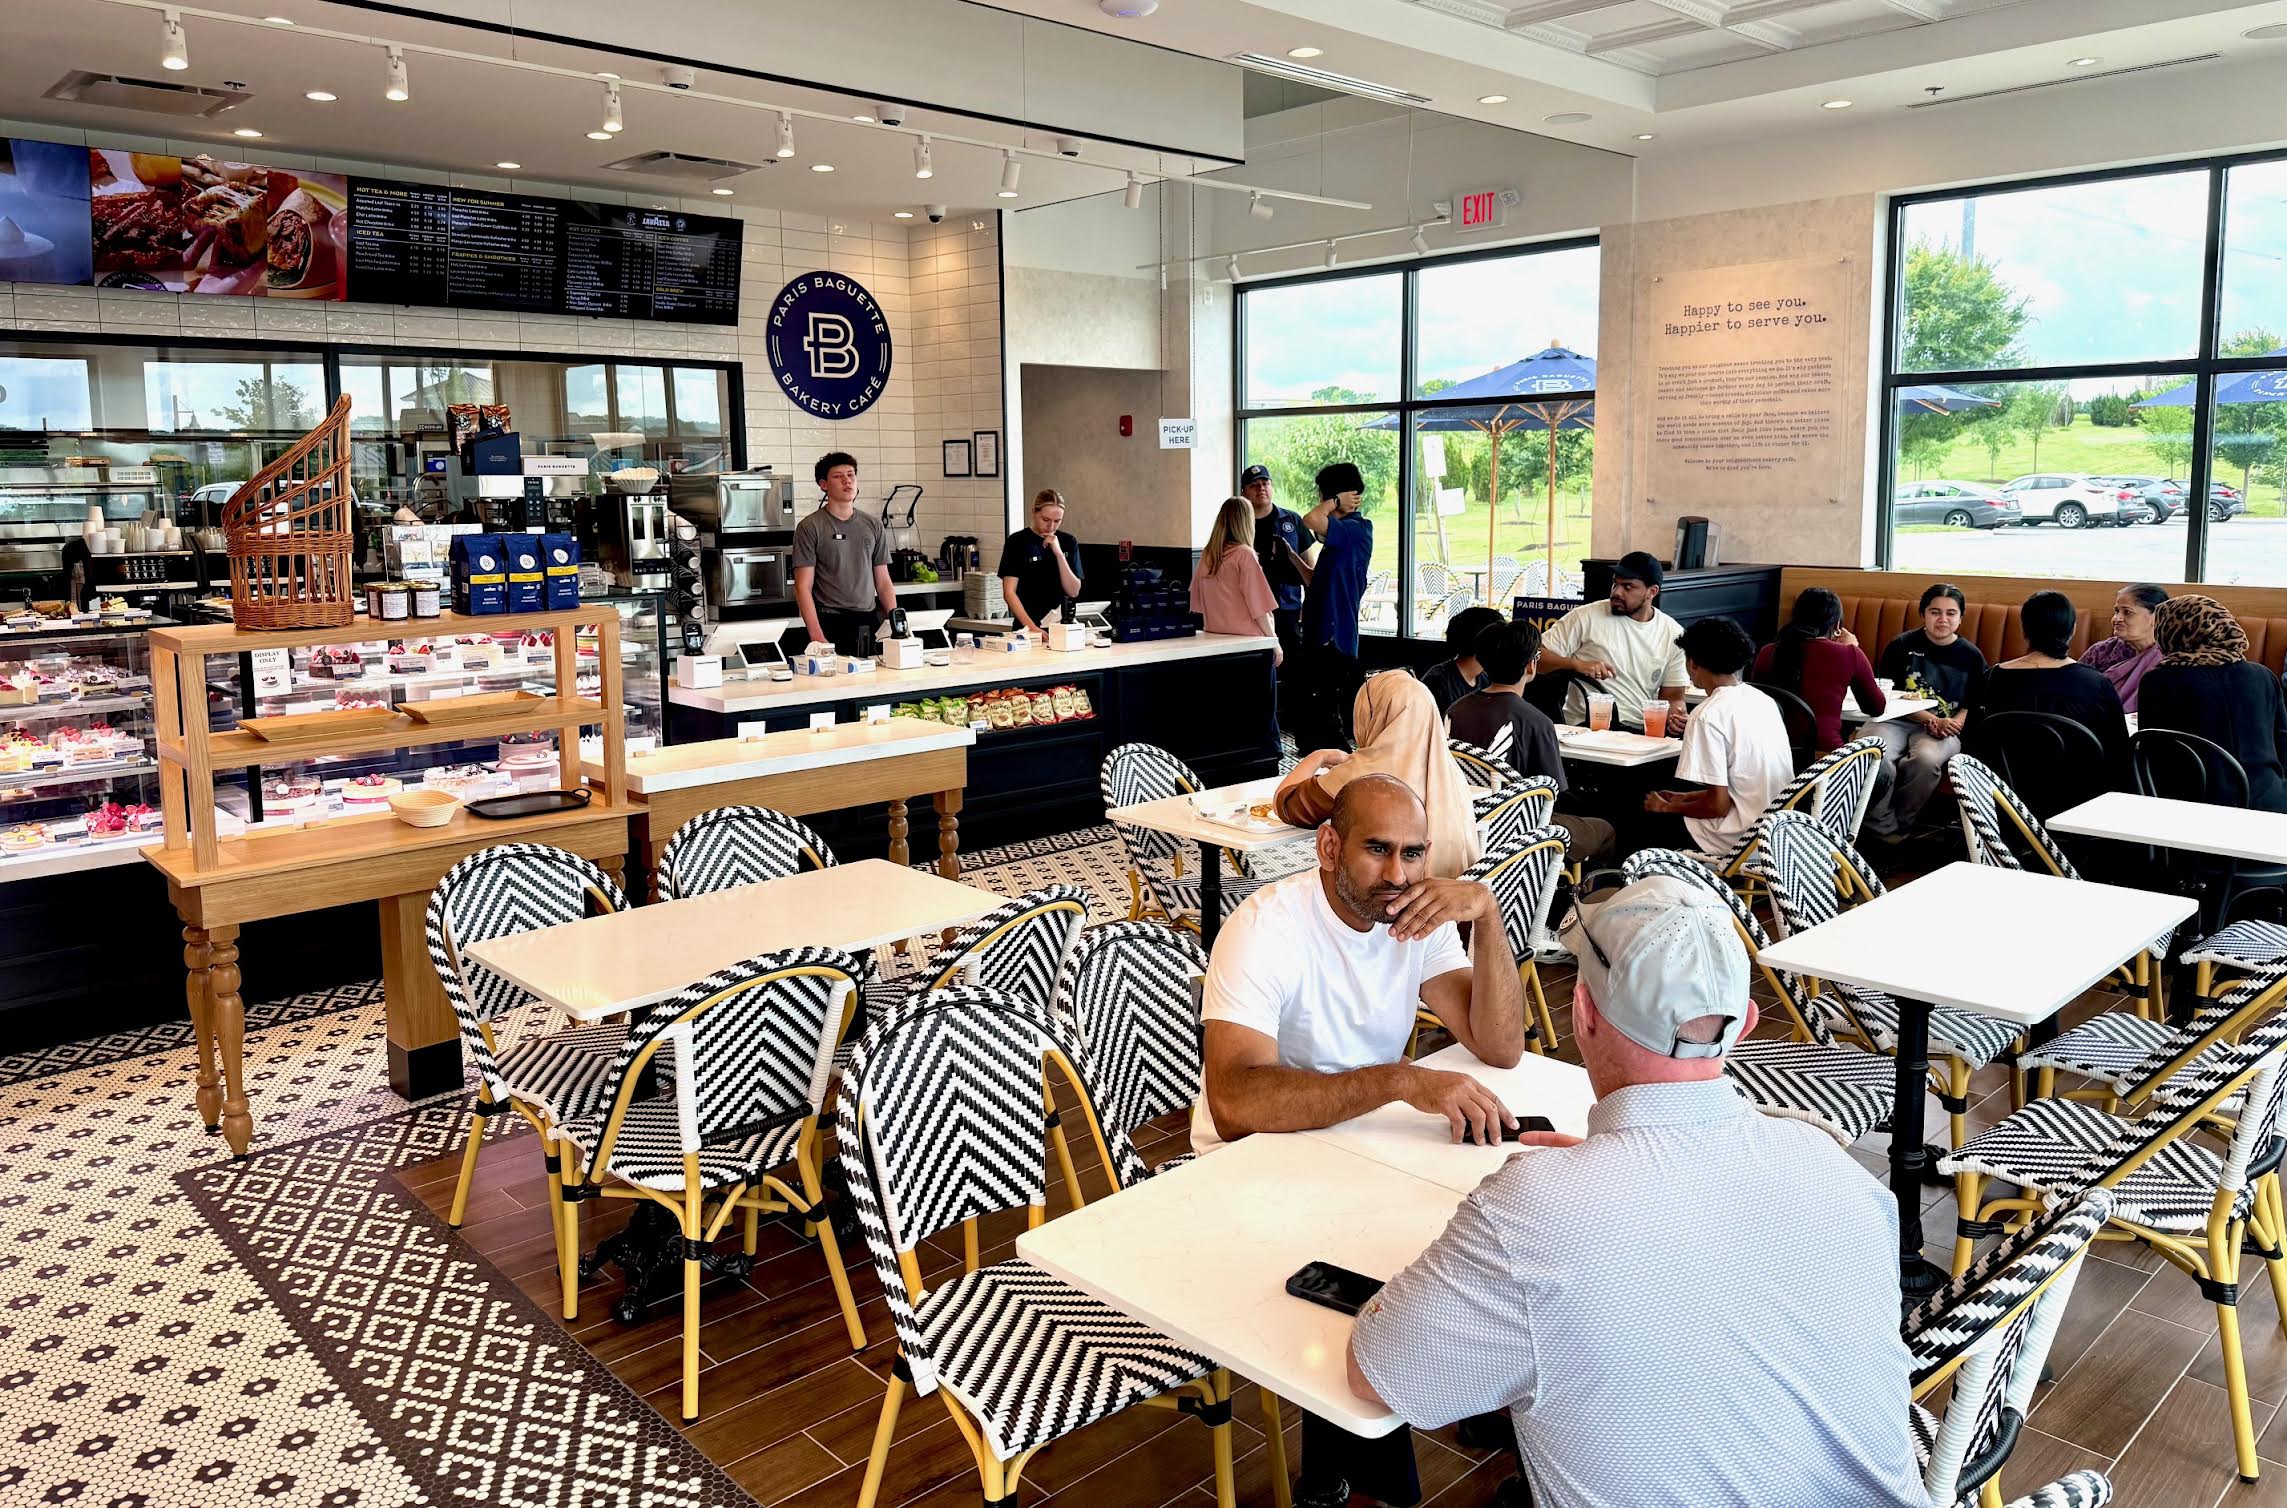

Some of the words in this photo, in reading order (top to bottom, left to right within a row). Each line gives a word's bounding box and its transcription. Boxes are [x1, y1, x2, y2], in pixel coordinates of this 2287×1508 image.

[1463, 192, 1495, 225] EXIT
[774, 282, 807, 327] PARIS
[814, 277, 885, 335] BAGUETTE
[1684, 304, 1720, 318] Happy
[1728, 302, 1742, 312] to
[1748, 300, 1770, 311] see
[1776, 298, 1806, 310] you.
[1665, 321, 1720, 336] Happier
[1726, 320, 1742, 330] to
[1748, 316, 1789, 328] serve
[1794, 314, 1826, 326] you.
[782, 372, 841, 415] BAKERY
[849, 376, 882, 411] CAFÉ
[1168, 436, 1190, 444] HERE
[1516, 601, 1544, 609] PARIS
